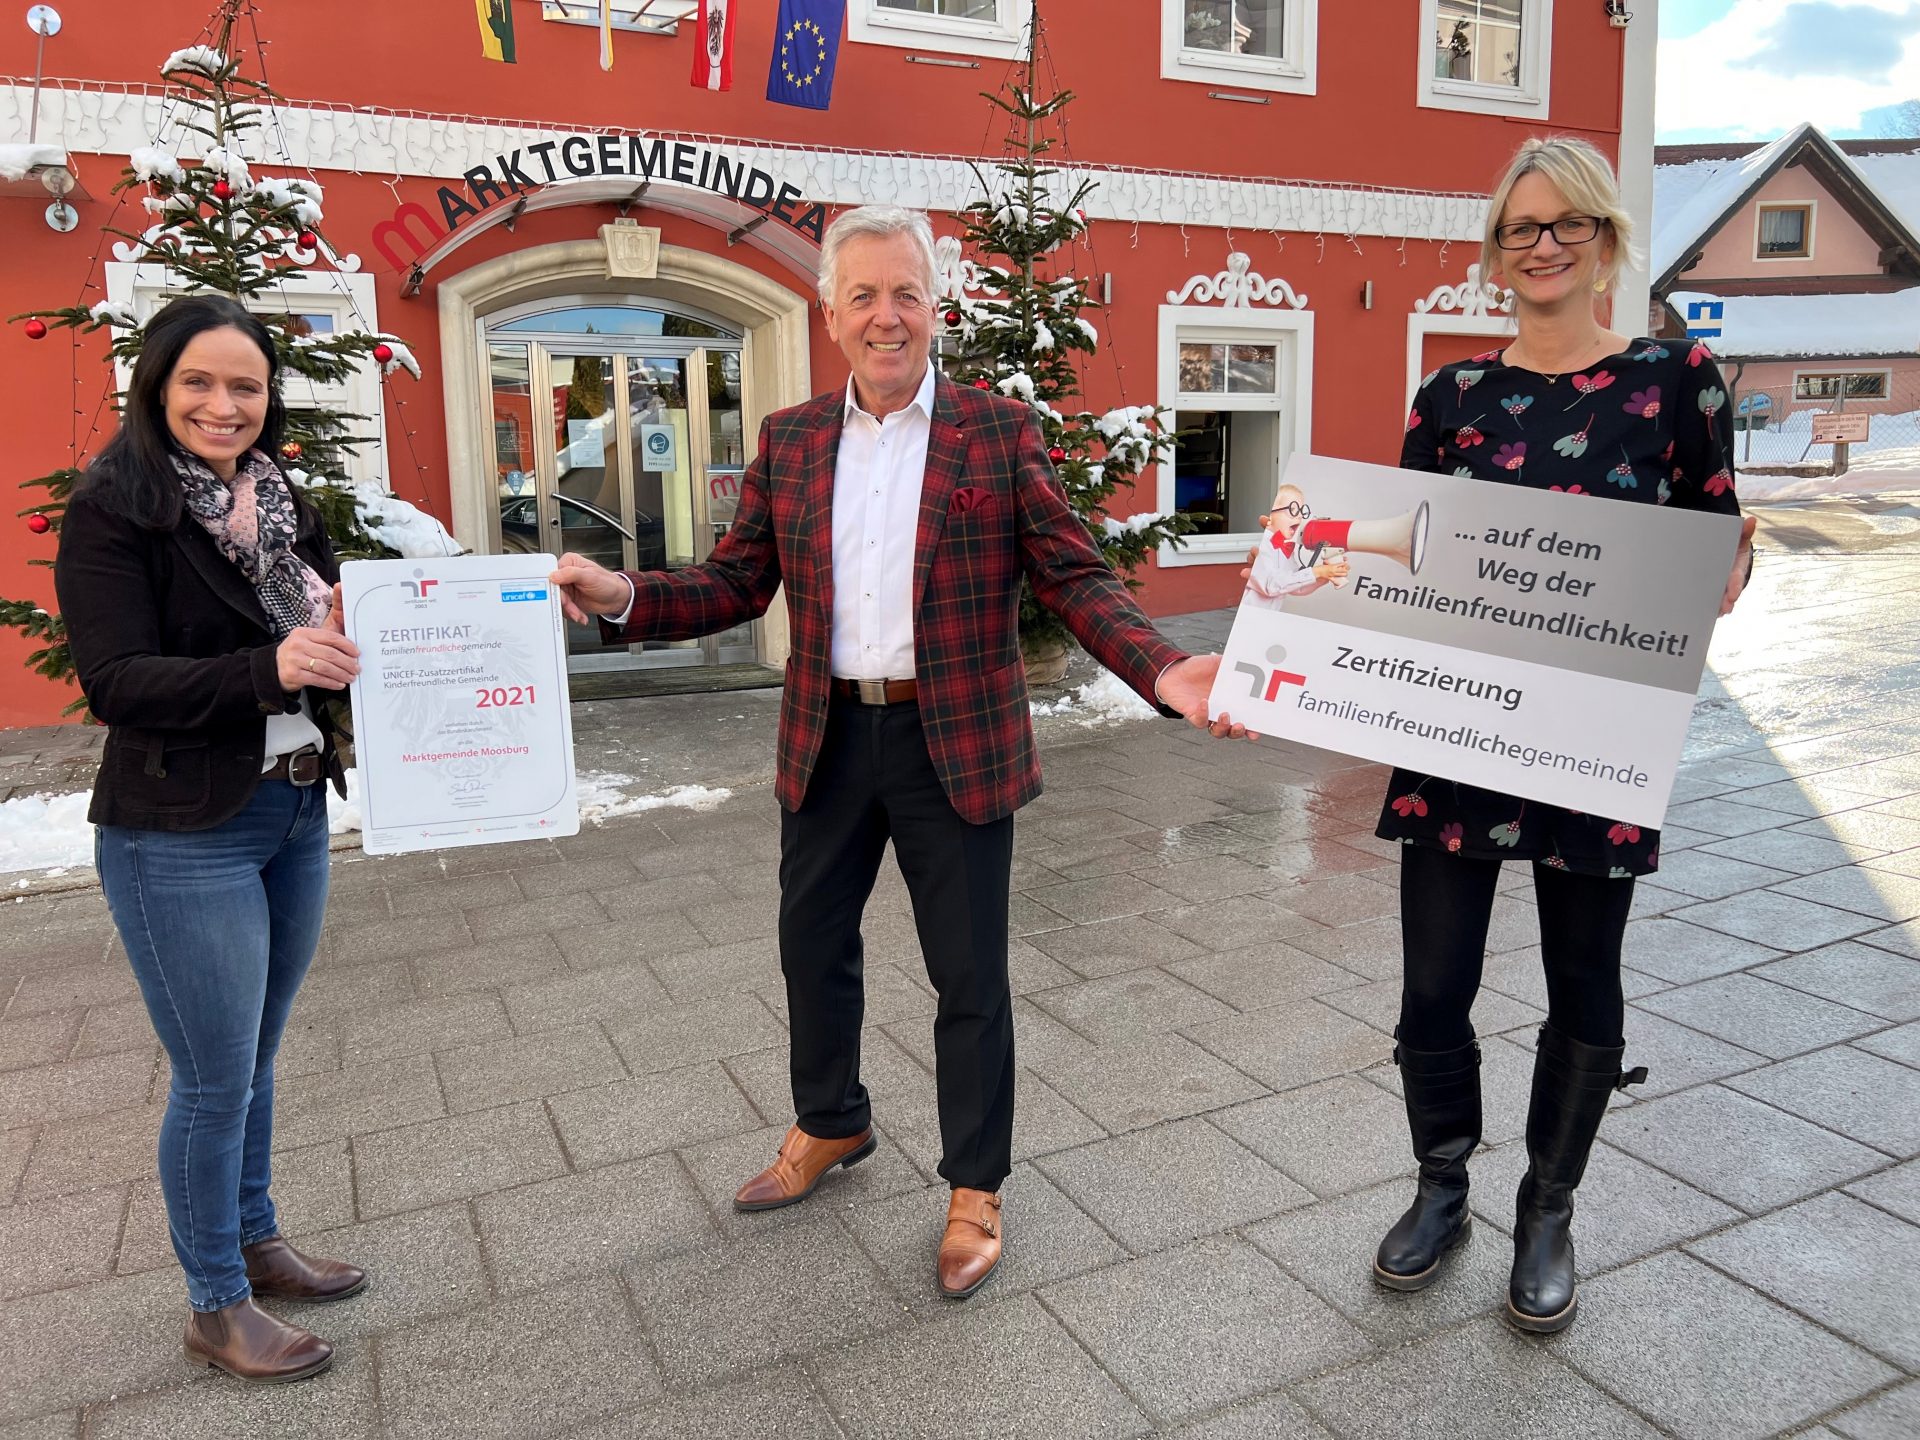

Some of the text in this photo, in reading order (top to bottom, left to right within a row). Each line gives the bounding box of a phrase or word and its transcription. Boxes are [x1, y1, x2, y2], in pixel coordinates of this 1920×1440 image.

[372, 136, 826, 274] mARKTGEMEINDEA
[1484, 527, 1535, 549] auf
[1537, 532, 1602, 561] dem
[1477, 557, 1596, 597] Weg der
[502, 592, 526, 602] unicef
[1353, 575, 1689, 657] Familienfreundlichkeit!
[379, 625, 472, 643] ZERTIFIKAT
[381, 641, 502, 656] familienfreundlichegemeinde
[383, 666, 484, 680] UNICEF-Zusatzzertifikat
[384, 674, 499, 689] Kinderfreundliche Gemeinde
[1331, 646, 1523, 711] Zertifizierung
[475, 685, 536, 708] 2021
[1297, 690, 1649, 788] familienfreundlichegemeinde
[402, 745, 529, 763] Marktgemeinde Moosburg
